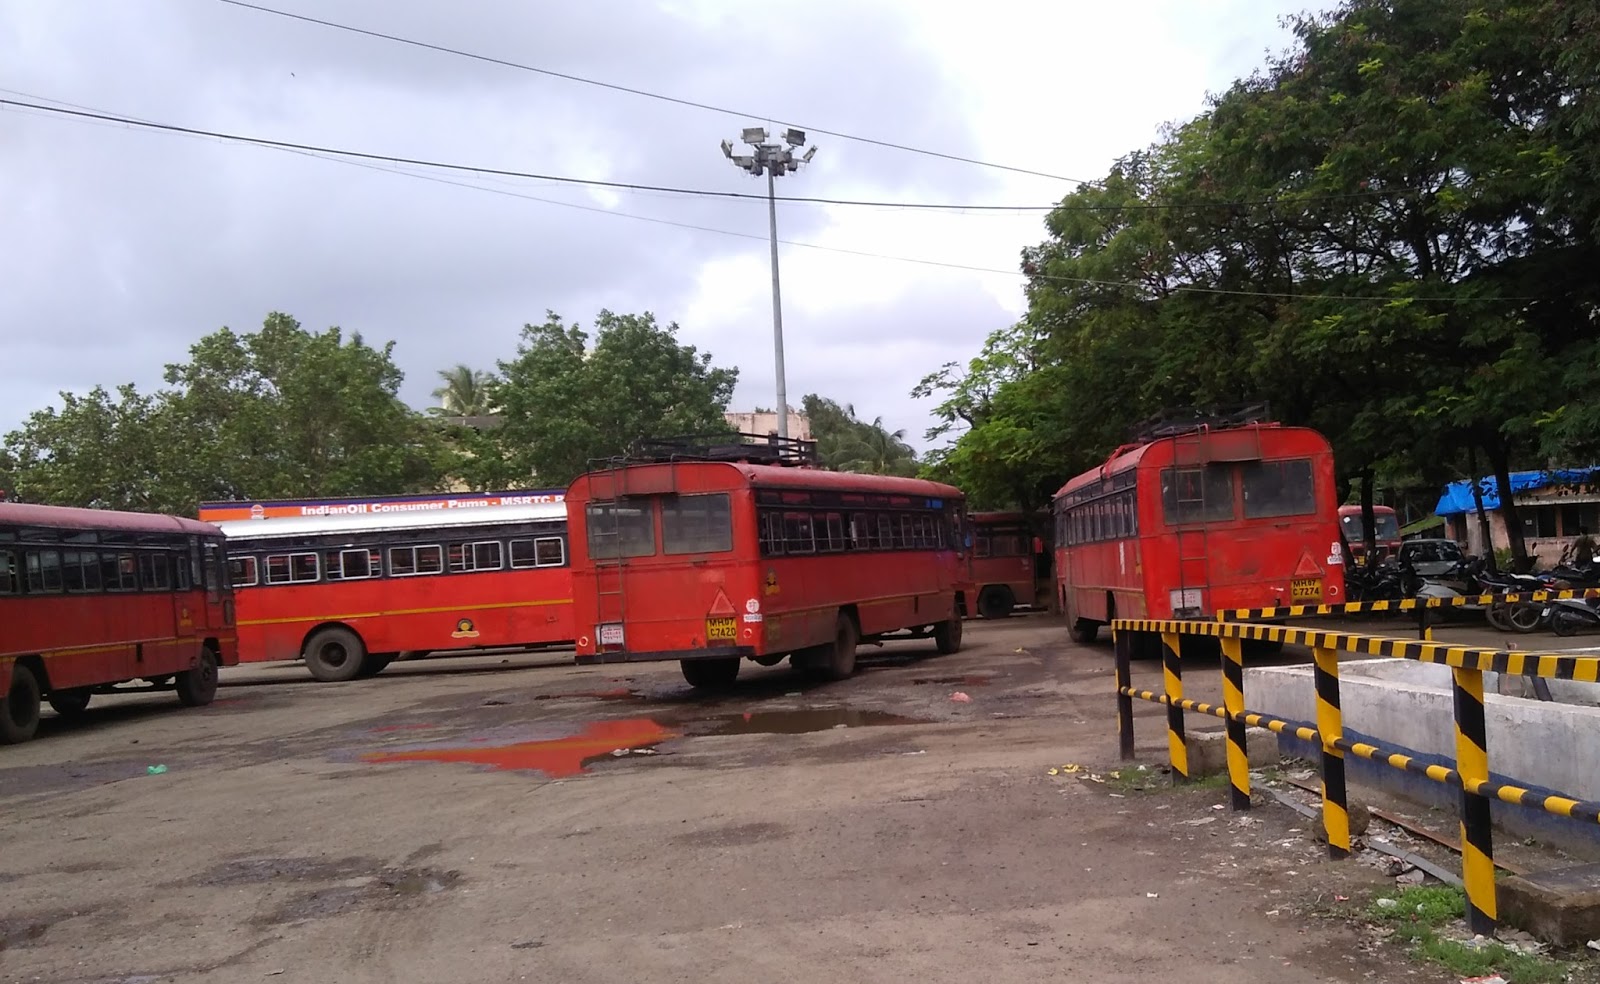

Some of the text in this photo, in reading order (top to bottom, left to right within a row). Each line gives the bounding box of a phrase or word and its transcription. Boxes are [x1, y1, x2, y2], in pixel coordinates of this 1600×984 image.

[301, 504, 367, 515] IndianOil
[371, 502, 445, 513] Consumer
[500, 495, 550, 506] MSRTC
